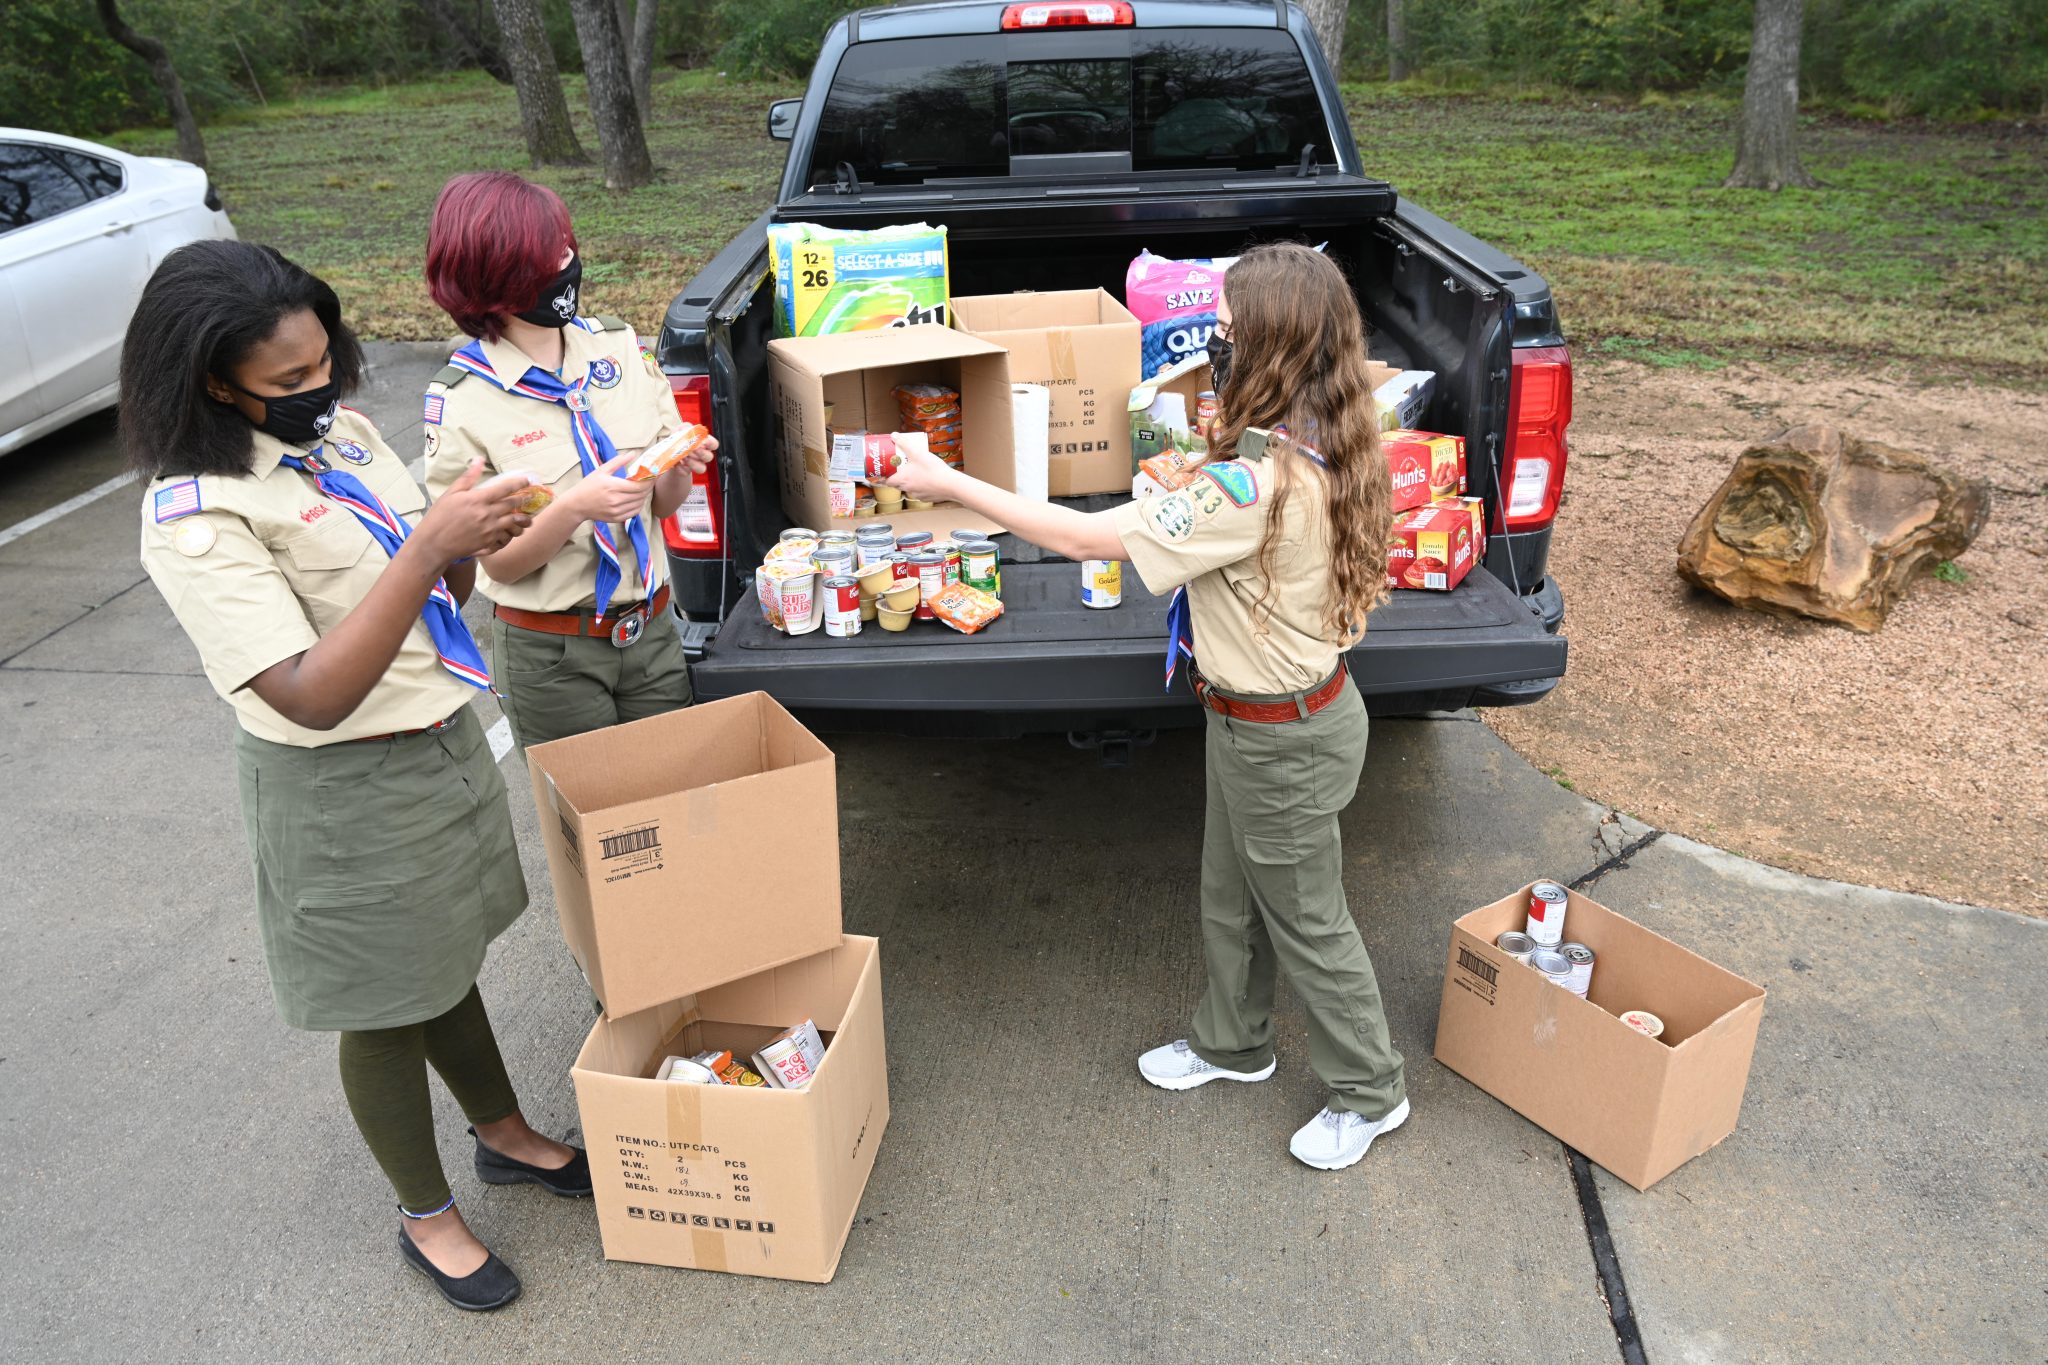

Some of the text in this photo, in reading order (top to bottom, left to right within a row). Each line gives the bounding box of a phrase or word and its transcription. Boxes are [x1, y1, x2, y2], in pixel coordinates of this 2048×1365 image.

[803, 252, 819, 265] 12
[802, 270, 829, 287] 26
[1166, 288, 1213, 310] SAVE
[525, 430, 547, 446] BSA
[1459, 441, 1465, 453] 8
[309, 504, 331, 519] BSA
[615, 1134, 720, 1154] ITEM NO.: UTP CAT6
[619, 1148, 645, 1159] QTY:
[724, 1160, 747, 1169] PCS
[732, 1173, 749, 1182] KG
[625, 1181, 659, 1193] MEAS:
[734, 1195, 751, 1203] CM
[734, 1184, 750, 1193] KG
